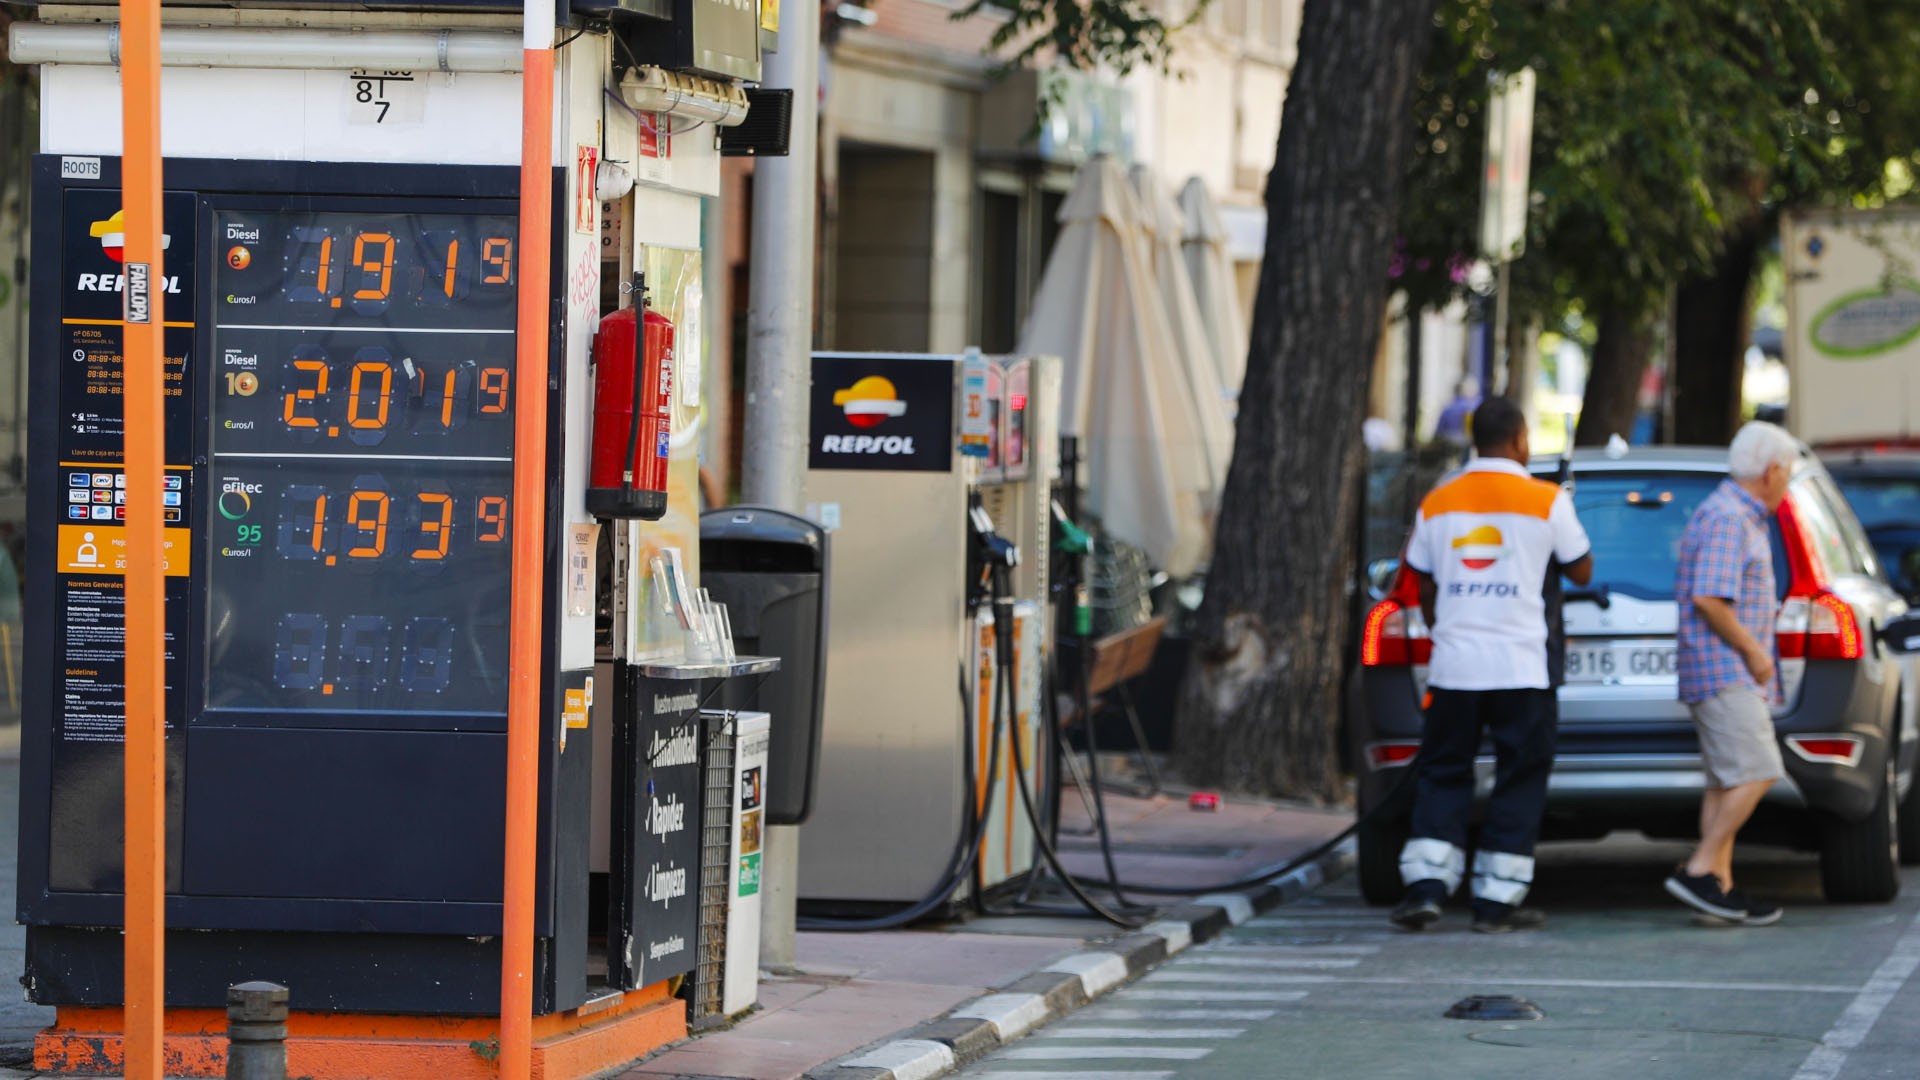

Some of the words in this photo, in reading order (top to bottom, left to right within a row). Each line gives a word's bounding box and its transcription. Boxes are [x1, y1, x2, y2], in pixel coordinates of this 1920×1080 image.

[63, 161, 99, 175] ROOTS
[227, 228, 259, 240] Diesel
[130, 264, 147, 321] FARLOPA
[225, 354, 257, 366] Diesel
[822, 435, 914, 454] REPSOL
[223, 482, 263, 494] efitec
[237, 524, 262, 542] 95
[653, 724, 697, 768] Amabilidad
[652, 792, 684, 843] Rapidez
[652, 860, 686, 909] Limpieza
